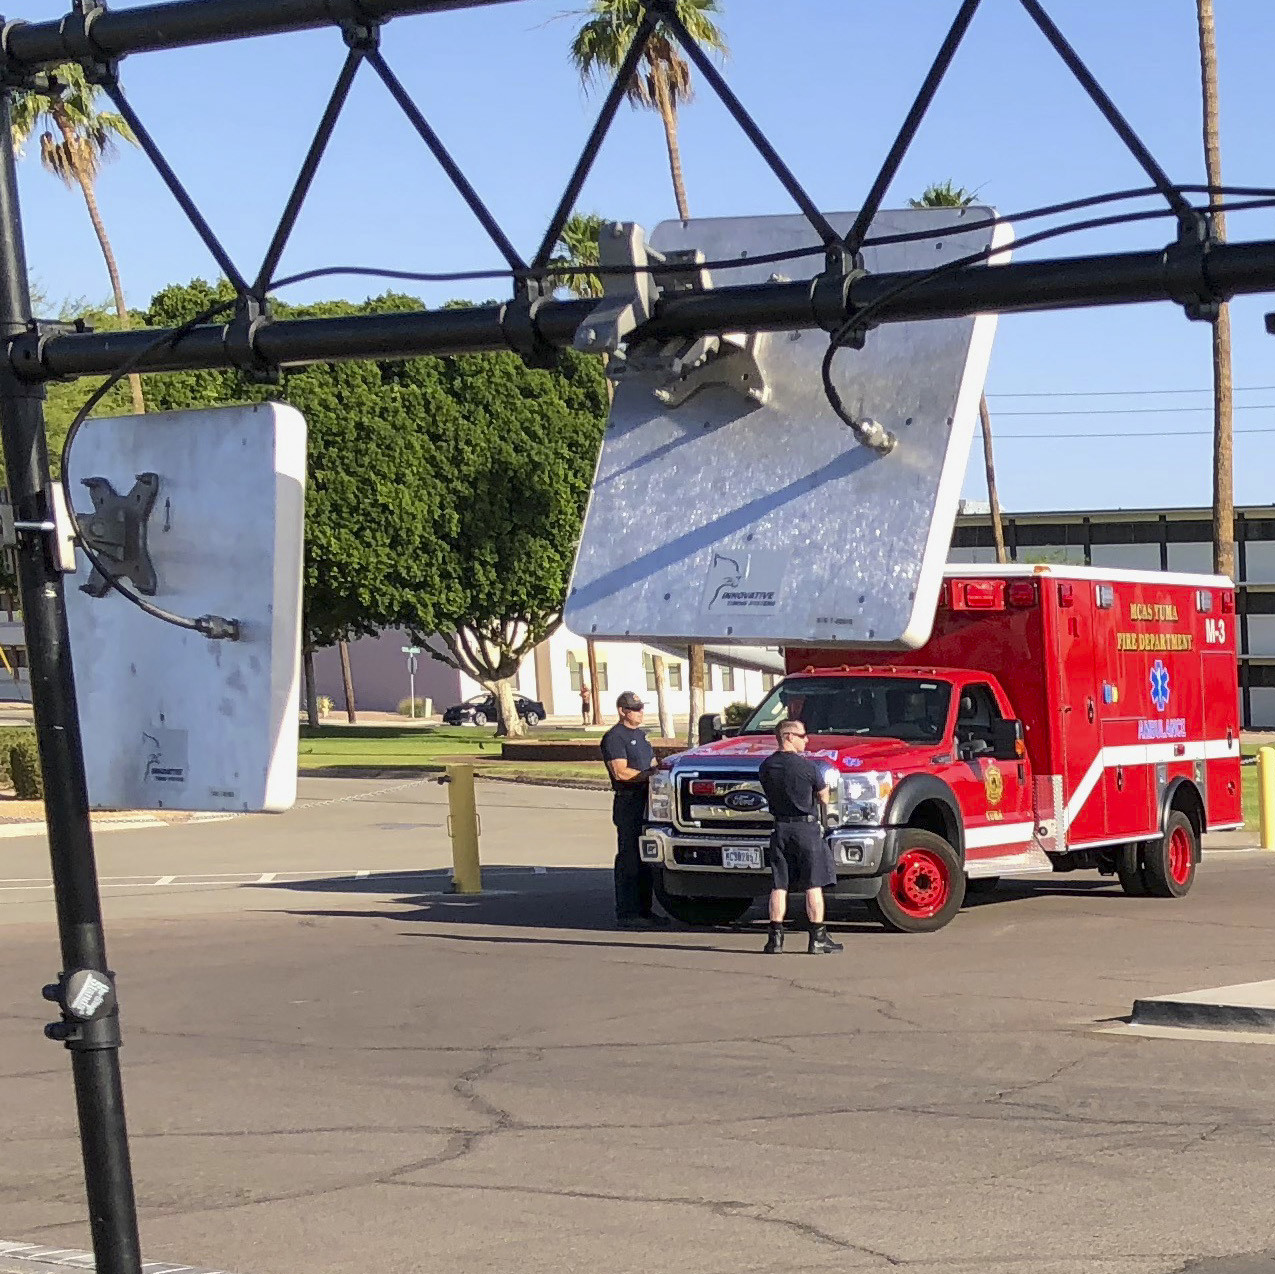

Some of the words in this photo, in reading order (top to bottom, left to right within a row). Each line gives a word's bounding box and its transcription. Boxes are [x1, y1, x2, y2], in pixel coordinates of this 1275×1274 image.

[722, 591, 775, 600] INNOVATIVE
[1130, 603, 1153, 621] MCAS
[1154, 604, 1179, 622] YUMA
[1205, 617, 1227, 645] M-3
[1116, 632, 1138, 651] FIRE
[1138, 633, 1194, 651] DEPARTMENT
